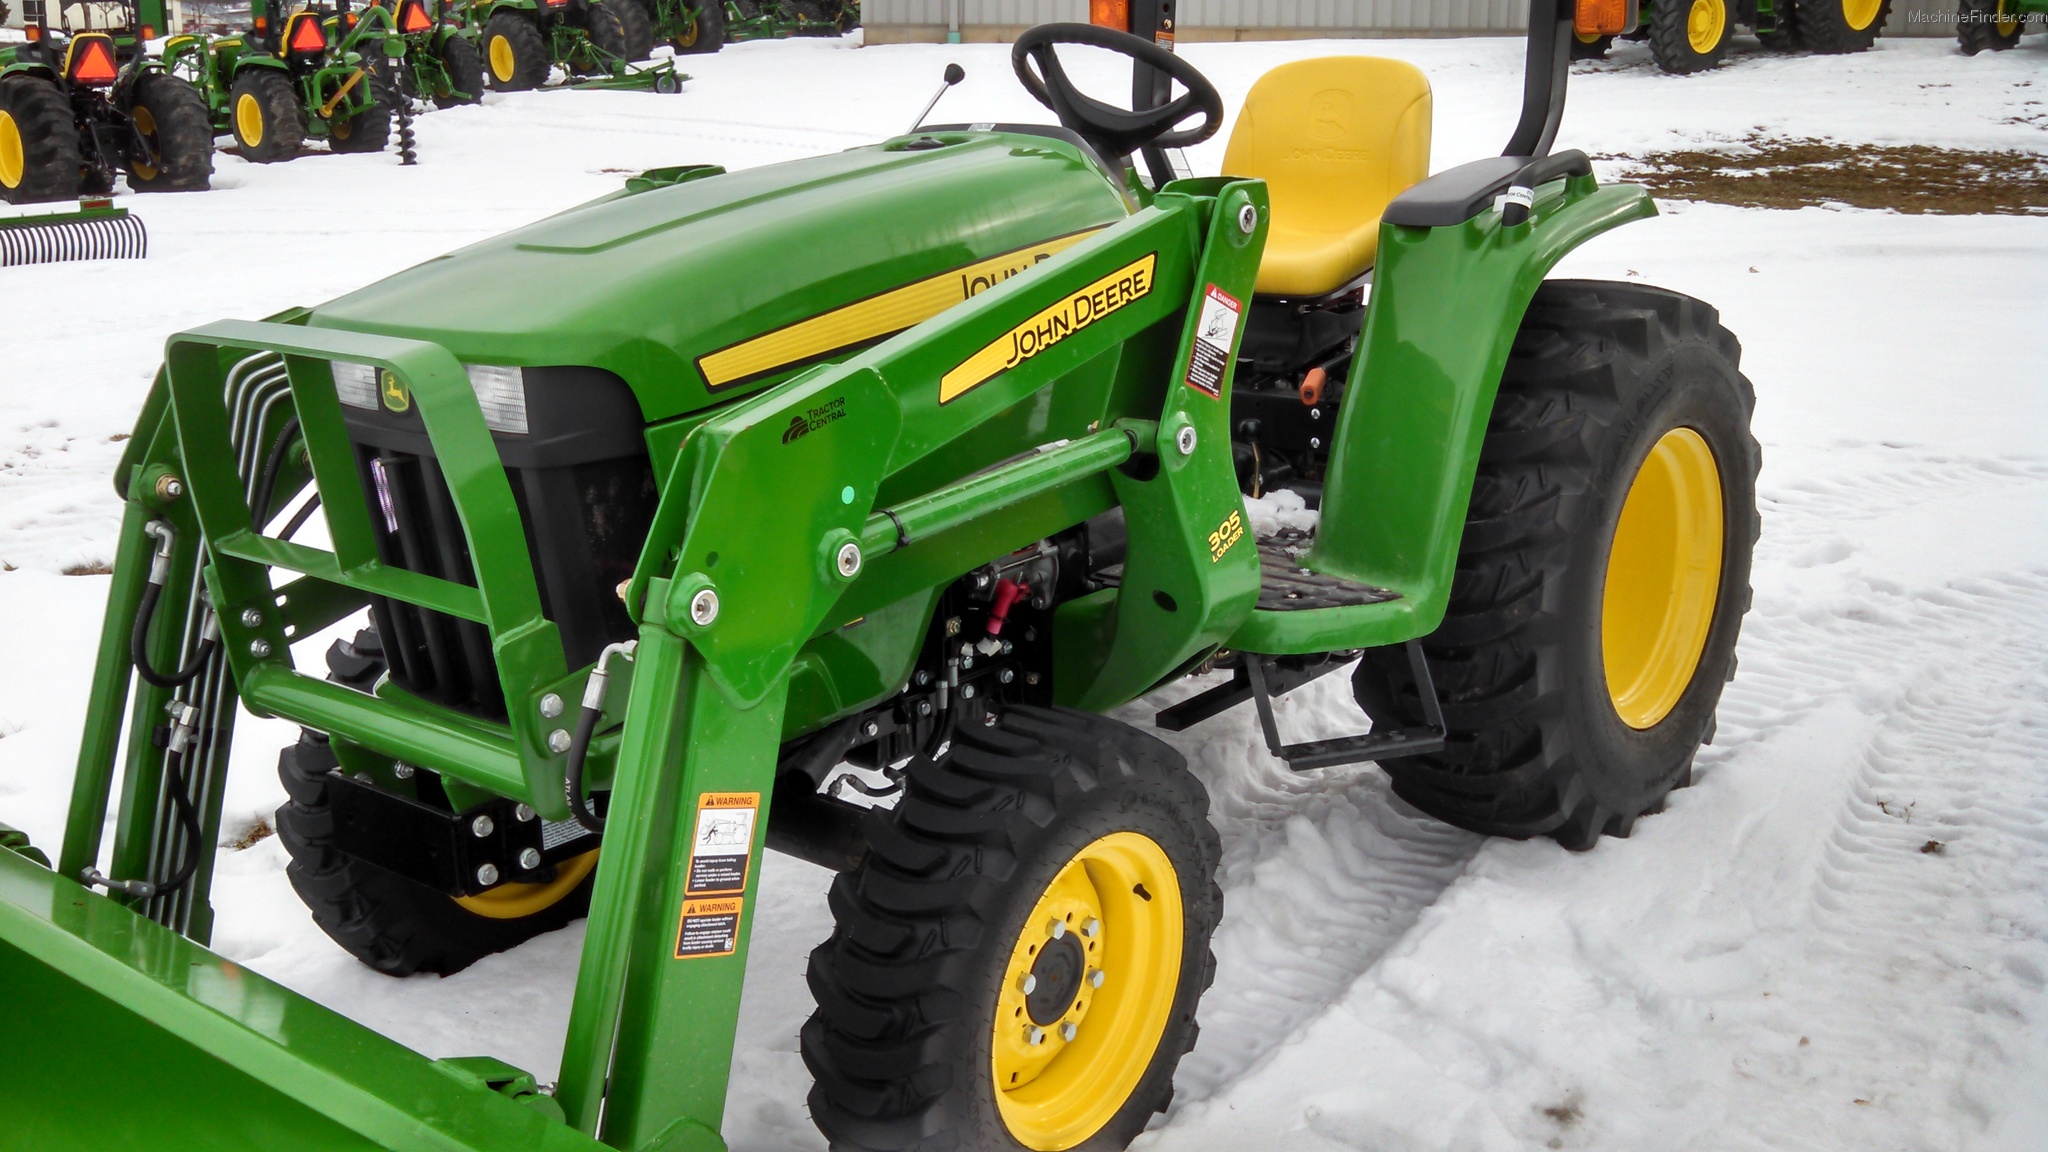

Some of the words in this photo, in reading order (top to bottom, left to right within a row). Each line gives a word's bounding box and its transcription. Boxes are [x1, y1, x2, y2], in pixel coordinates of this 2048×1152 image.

[1324, 146, 1368, 163] DEERE
[1217, 293, 1238, 311] DANGER
[1006, 309, 1070, 365] JOHN
[1073, 269, 1147, 327] DEERE
[806, 396, 846, 421] TRACTOR
[809, 408, 847, 432] CENTRAL
[1208, 509, 1241, 552] 305
[1212, 526, 1244, 563] LOADER
[715, 796, 753, 806] WARNING
[699, 902, 736, 913] WARNING
